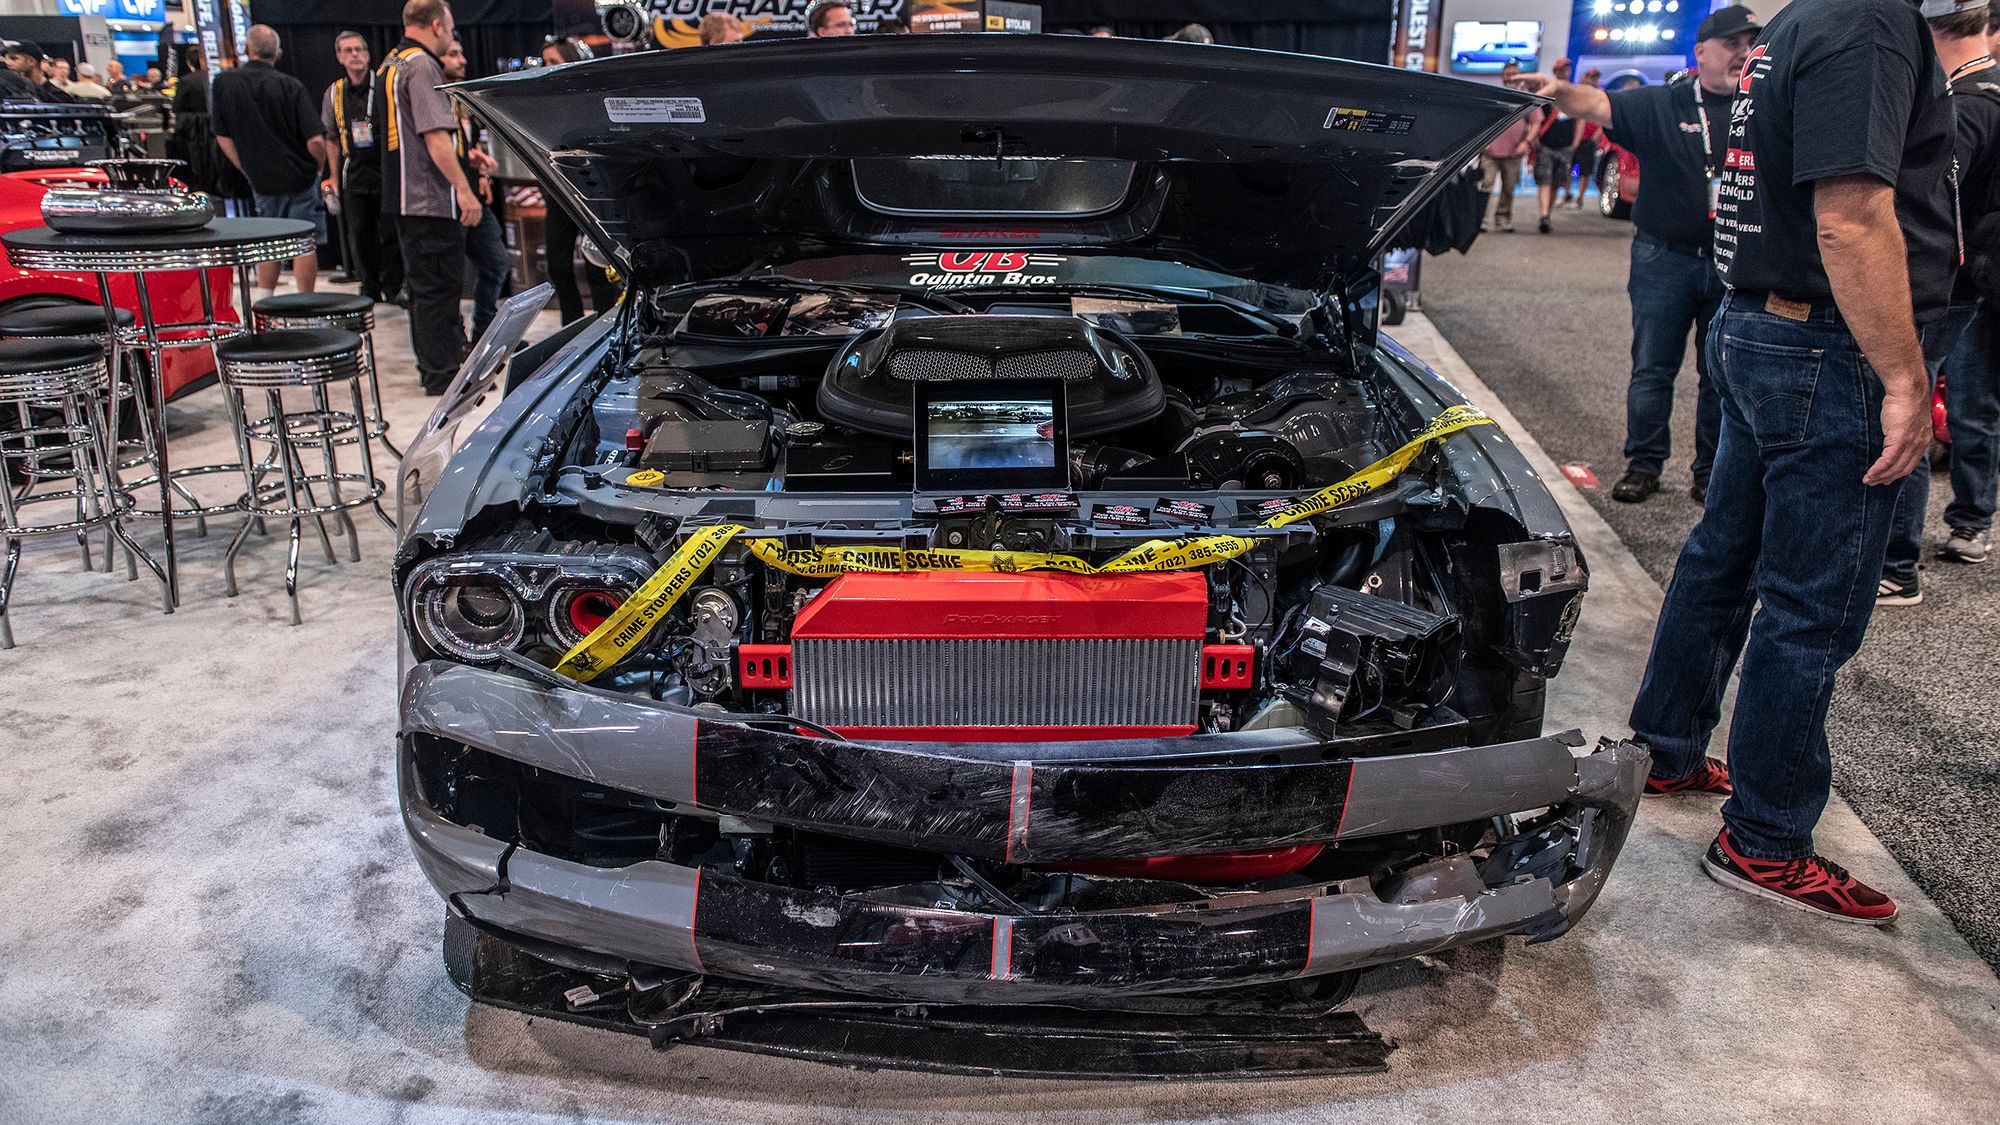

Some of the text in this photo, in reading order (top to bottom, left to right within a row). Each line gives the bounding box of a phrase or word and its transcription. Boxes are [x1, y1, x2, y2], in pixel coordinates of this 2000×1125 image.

[939, 227, 1039, 239] SHAKER
[909, 272, 1057, 286] Quintin Bros
[1282, 480, 1372, 518] CRIME SCENE
[843, 551, 901, 569] CRIME
[905, 551, 964, 569] SCENE
[1155, 554, 1186, 571] (702)
[1189, 539, 1240, 561] 385-5555
[613, 617, 648, 648] CRIME
[643, 567, 692, 620] STOPPERS
[687, 539, 717, 570] (702)
